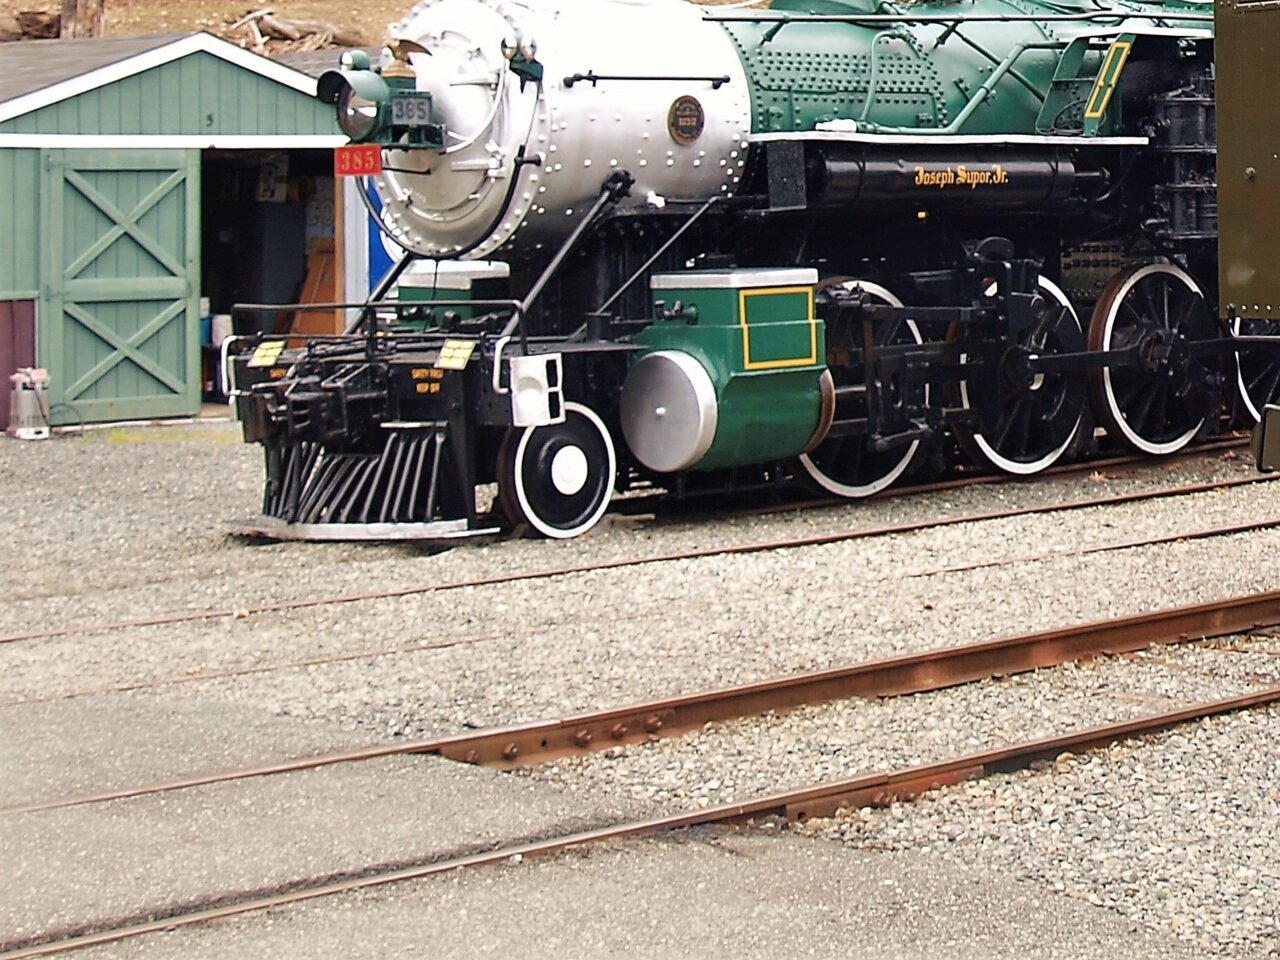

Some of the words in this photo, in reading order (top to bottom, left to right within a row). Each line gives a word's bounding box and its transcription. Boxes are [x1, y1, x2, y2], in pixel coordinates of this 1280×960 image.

[394, 101, 427, 119] 385
[341, 150, 375, 170] 385
[914, 165, 954, 188] Joseph
